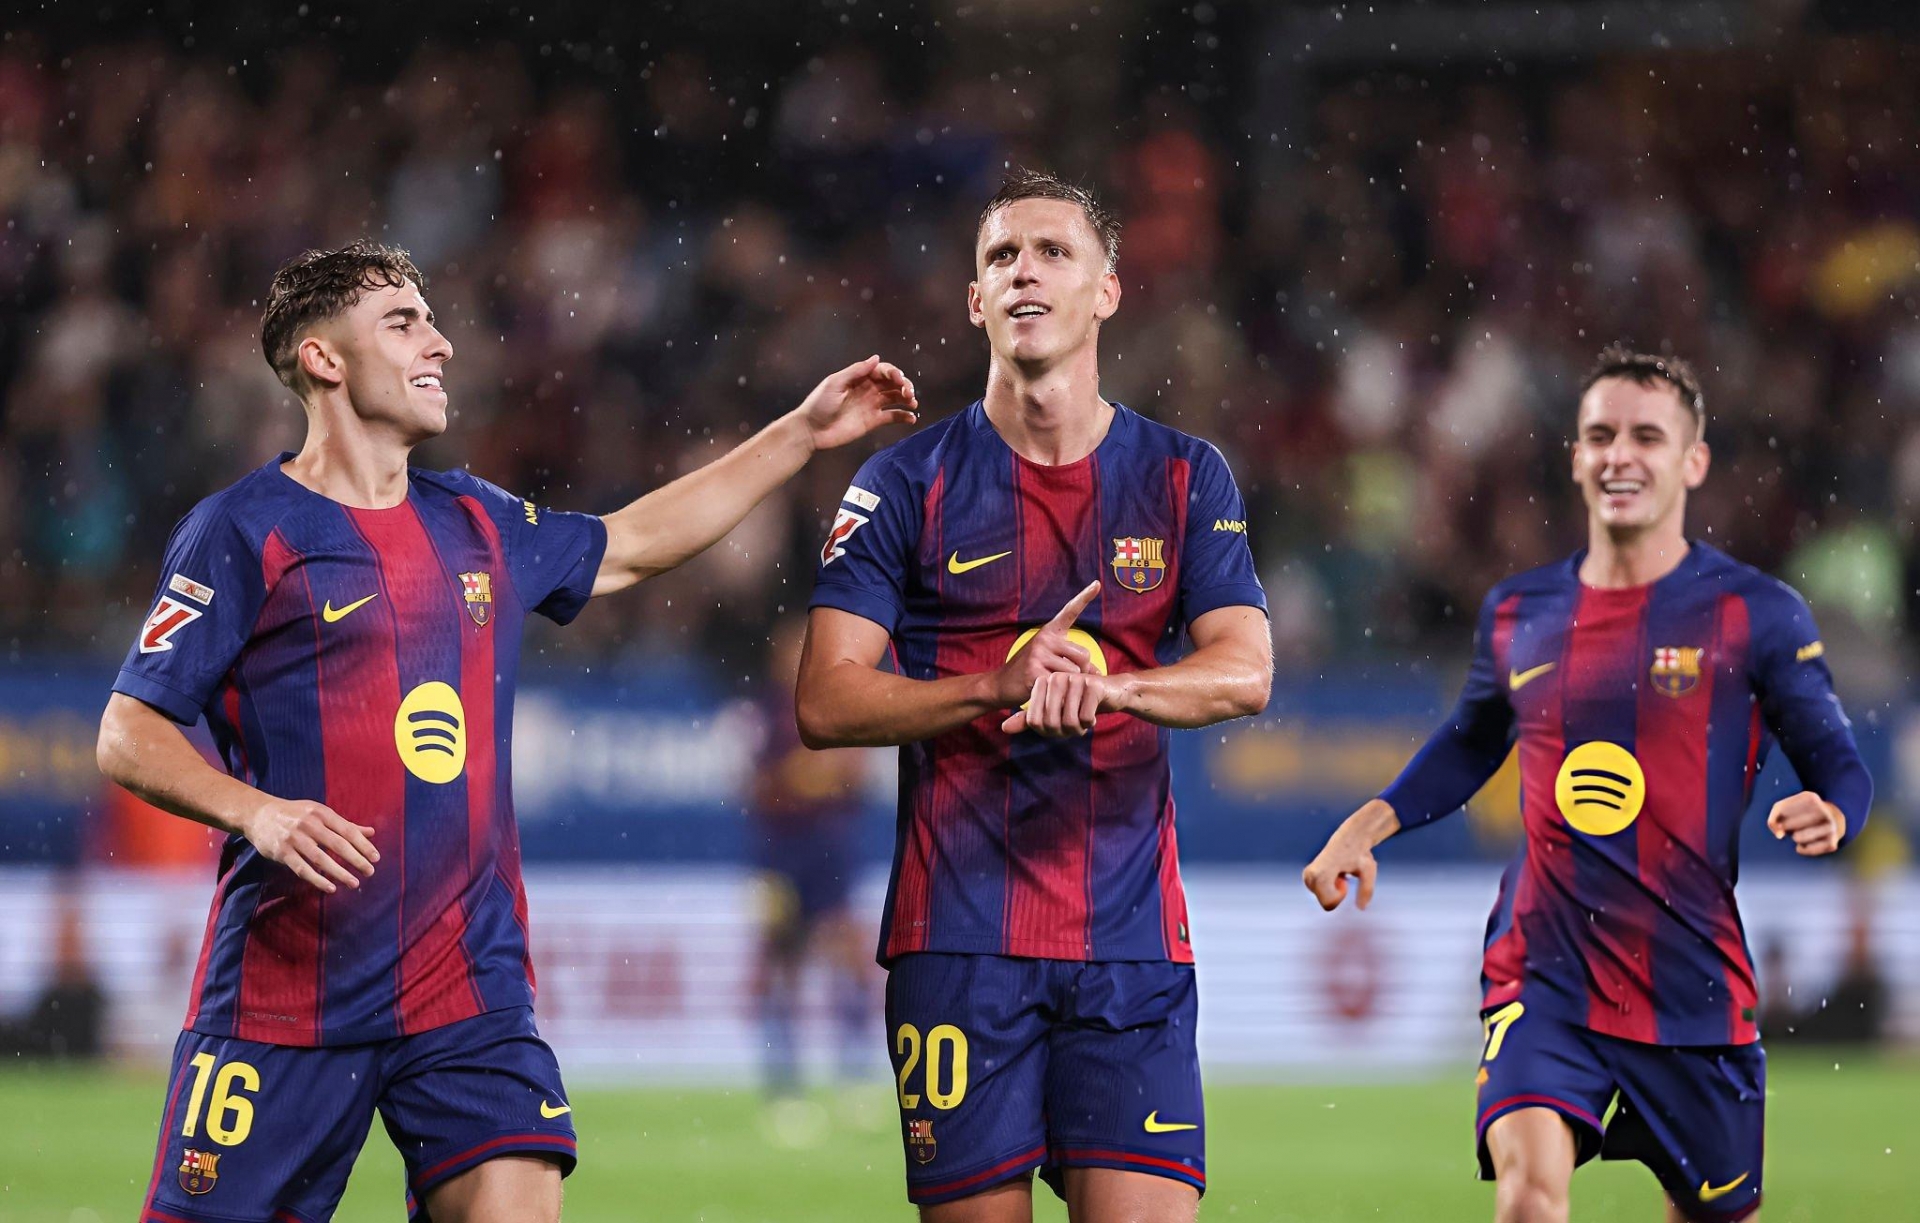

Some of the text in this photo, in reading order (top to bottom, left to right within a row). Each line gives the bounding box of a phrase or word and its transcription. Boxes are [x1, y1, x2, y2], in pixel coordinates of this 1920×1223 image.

[897, 1023, 968, 1110] 20
[1483, 1001, 1525, 1061] 7
[181, 1052, 260, 1146] 16
